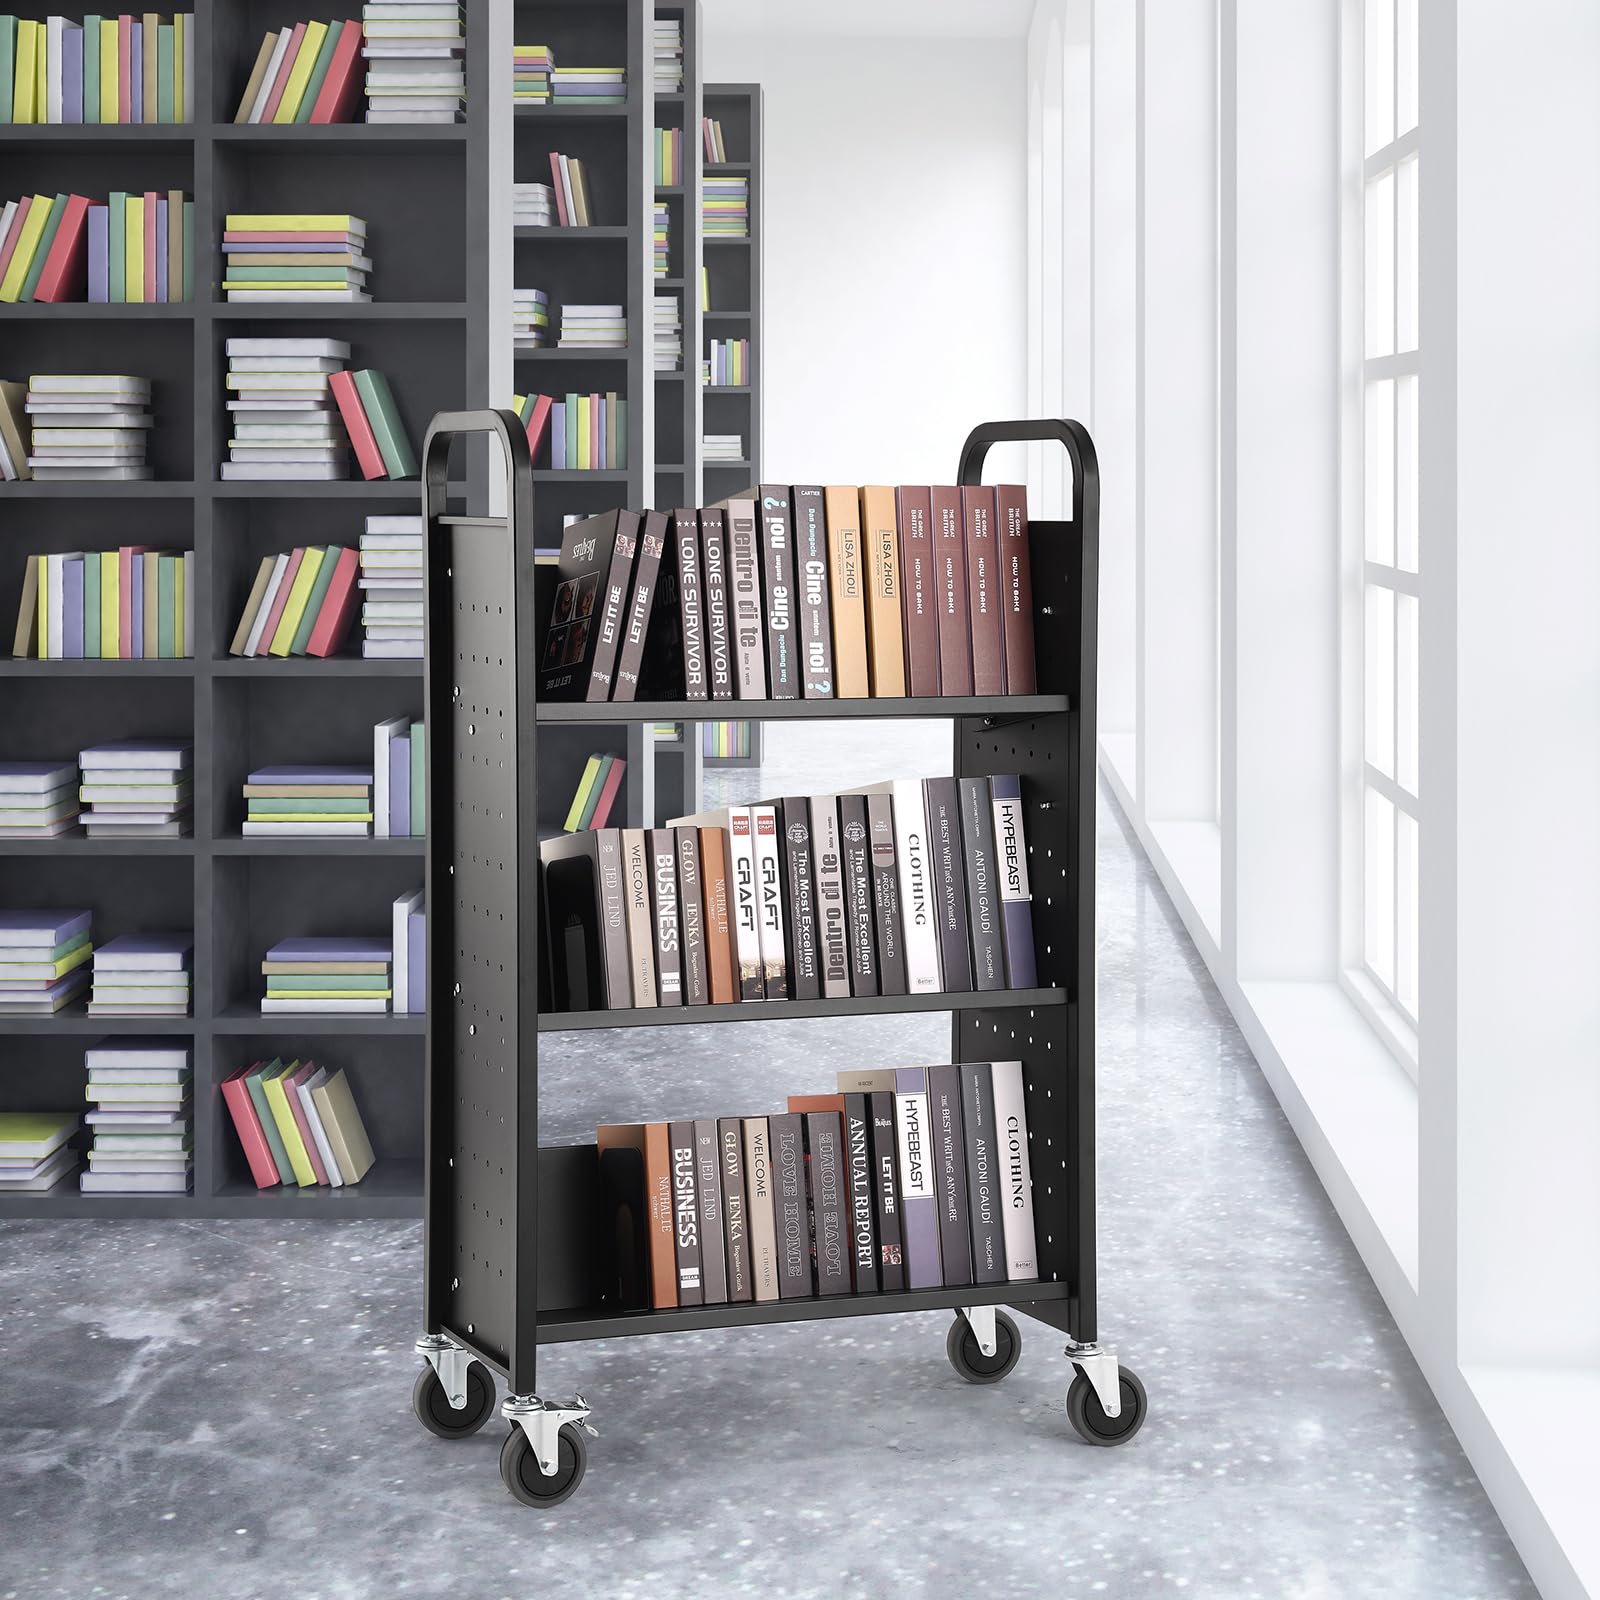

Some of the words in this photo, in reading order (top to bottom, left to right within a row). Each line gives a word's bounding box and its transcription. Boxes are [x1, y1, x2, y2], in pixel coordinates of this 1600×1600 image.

[682, 537, 696, 584] LONE
[708, 537, 722, 584] LONE
[733, 518, 754, 592] Dentro
[844, 532, 854, 559] LISA
[882, 533, 892, 559] LISA
[610, 585, 622, 604] BE
[637, 585, 648, 604] BE
[806, 560, 825, 605] Cine
[846, 561, 856, 595] ZHOU
[884, 561, 893, 595] ZHOU
[916, 580, 922, 590] TO
[948, 579, 953, 589] TO
[980, 579, 985, 588] TO
[1013, 578, 1019, 588] TO
[607, 604, 618, 618] IT
[634, 604, 645, 618] IT
[738, 600, 758, 620] di
[770, 585, 789, 631] Cine
[602, 621, 616, 644] LET
[630, 621, 643, 644] LET
[684, 588, 702, 684] SURVIVOR
[710, 588, 728, 684] SURVIVOR
[740, 626, 758, 647] te
[941, 820, 950, 844] BEST
[1002, 805, 1020, 894] HYPEBEAST
[604, 864, 617, 889] JED
[632, 845, 644, 908] WELCOME
[682, 840, 696, 885] GLOW
[798, 850, 807, 875] The
[821, 854, 838, 874] te
[854, 849, 864, 873] The
[908, 834, 926, 926] CLOTHING
[975, 850, 988, 894] ANTONI
[608, 896, 620, 928] LIND
[656, 854, 677, 953] BUSINESS
[715, 879, 728, 933] NATHALIE
[738, 857, 754, 931] CRAFT
[762, 856, 778, 930] CRAFT
[800, 880, 810, 912] Most
[821, 881, 840, 900] di
[856, 878, 866, 910] Most
[882, 872, 890, 907] AROUND
[886, 926, 894, 958] WORLD
[802, 916, 814, 977] Excellent
[825, 907, 845, 981] Dentro
[859, 913, 872, 975] Excellent
[942, 1109, 951, 1134] BEST
[725, 1132, 738, 1177] GLOW
[754, 1134, 766, 1197] WELCOME
[780, 1133, 797, 1197] LOVE
[850, 1118, 868, 1192] ANNUAL
[905, 1100, 923, 1190] HYPEBEAST
[976, 1138, 988, 1184] ANTONI
[1007, 1116, 1024, 1209] CLOTHING
[700, 1158, 713, 1180] JED
[819, 1133, 836, 1206] HOME
[881, 1156, 892, 1180] LET
[883, 1181, 893, 1194] IT
[659, 1176, 672, 1233] NATHALIE
[675, 1148, 697, 1248] BUSINESS
[703, 1188, 716, 1220] LIND
[885, 1196, 894, 1214] BE
[784, 1202, 802, 1277] HOME
[824, 1212, 841, 1276] LOVE
[855, 1195, 873, 1268] REPORT
